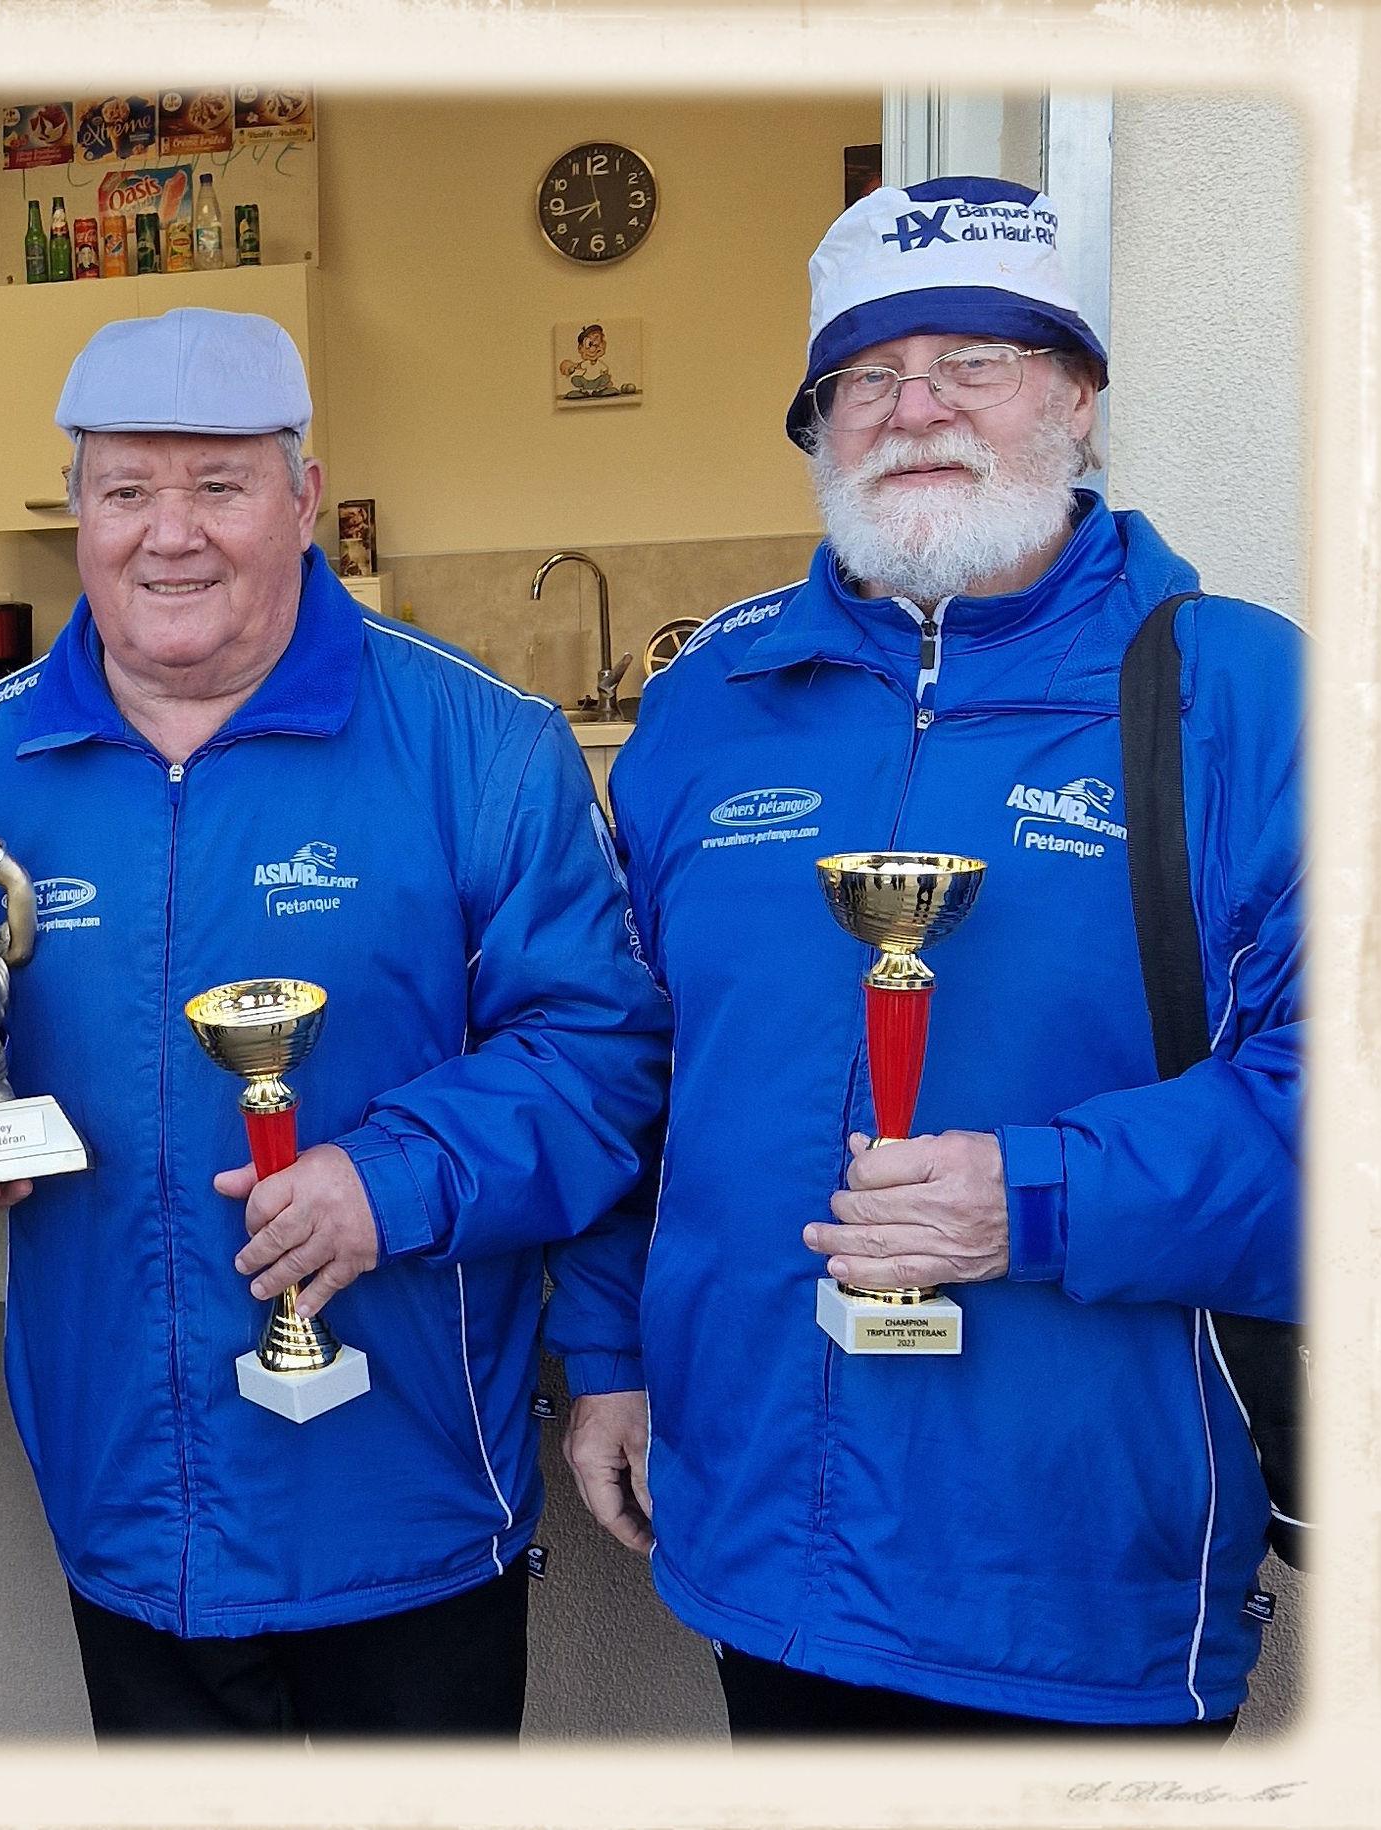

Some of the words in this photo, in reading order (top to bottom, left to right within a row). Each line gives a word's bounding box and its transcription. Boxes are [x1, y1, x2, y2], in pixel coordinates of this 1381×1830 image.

[586, 154, 609, 176] 12
[554, 178, 568, 191] 10
[628, 172, 639, 185] 2
[108, 175, 161, 211] Oasis
[628, 190, 646, 209] 3
[549, 197, 565, 217] 9
[955, 204, 1029, 221] Banque
[556, 222, 568, 235] 8
[628, 216, 639, 227] 4
[961, 223, 988, 242] du
[571, 237, 580, 251] 7
[590, 233, 606, 253] 6
[722, 600, 782, 633] eldera
[1025, 831, 1105, 859] Pétanque
[276, 897, 341, 917] Pétanque
[885, 1319, 929, 1327] CHAMPION
[866, 1329, 905, 1337] TRIPLETTE
[907, 1329, 948, 1337] VETERANS
